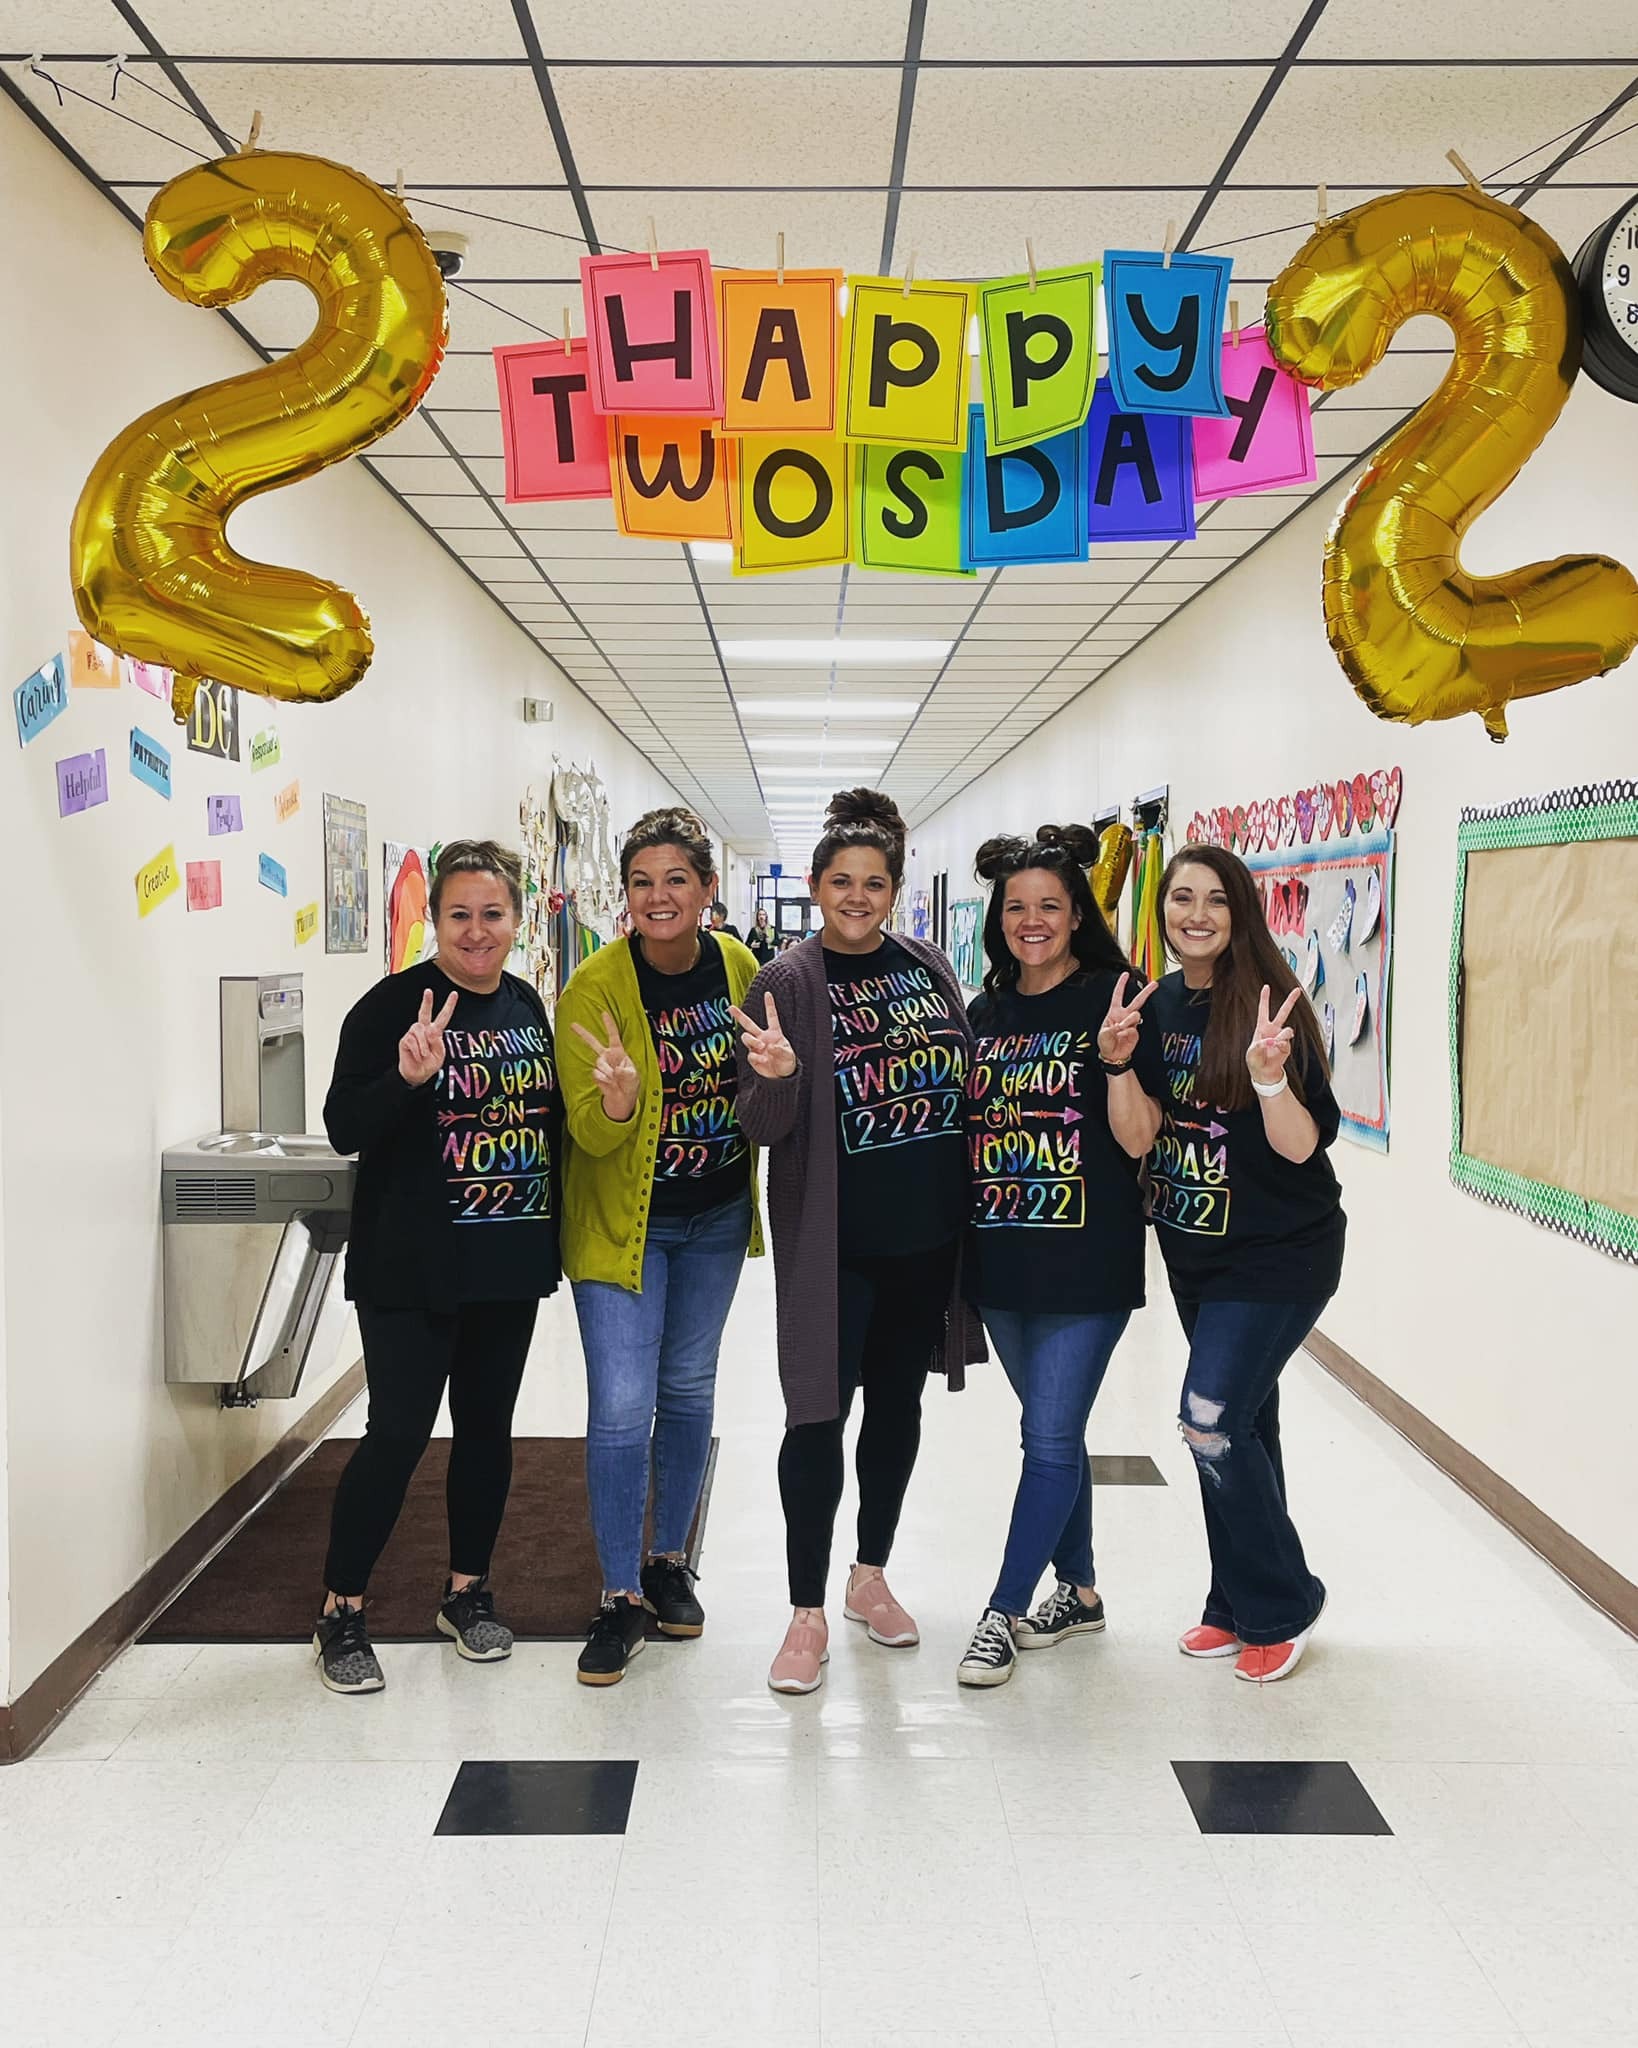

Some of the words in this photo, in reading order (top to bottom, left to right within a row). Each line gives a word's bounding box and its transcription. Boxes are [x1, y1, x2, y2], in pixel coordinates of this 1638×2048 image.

[1617, 263, 1630, 287] 9
[64, 764, 102, 800] Helpful
[827, 966, 933, 1008] TEACHING
[888, 992, 950, 1026] GRAD
[444, 1025, 545, 1060] TEACHING
[1001, 1059, 1085, 1098] GRADE
